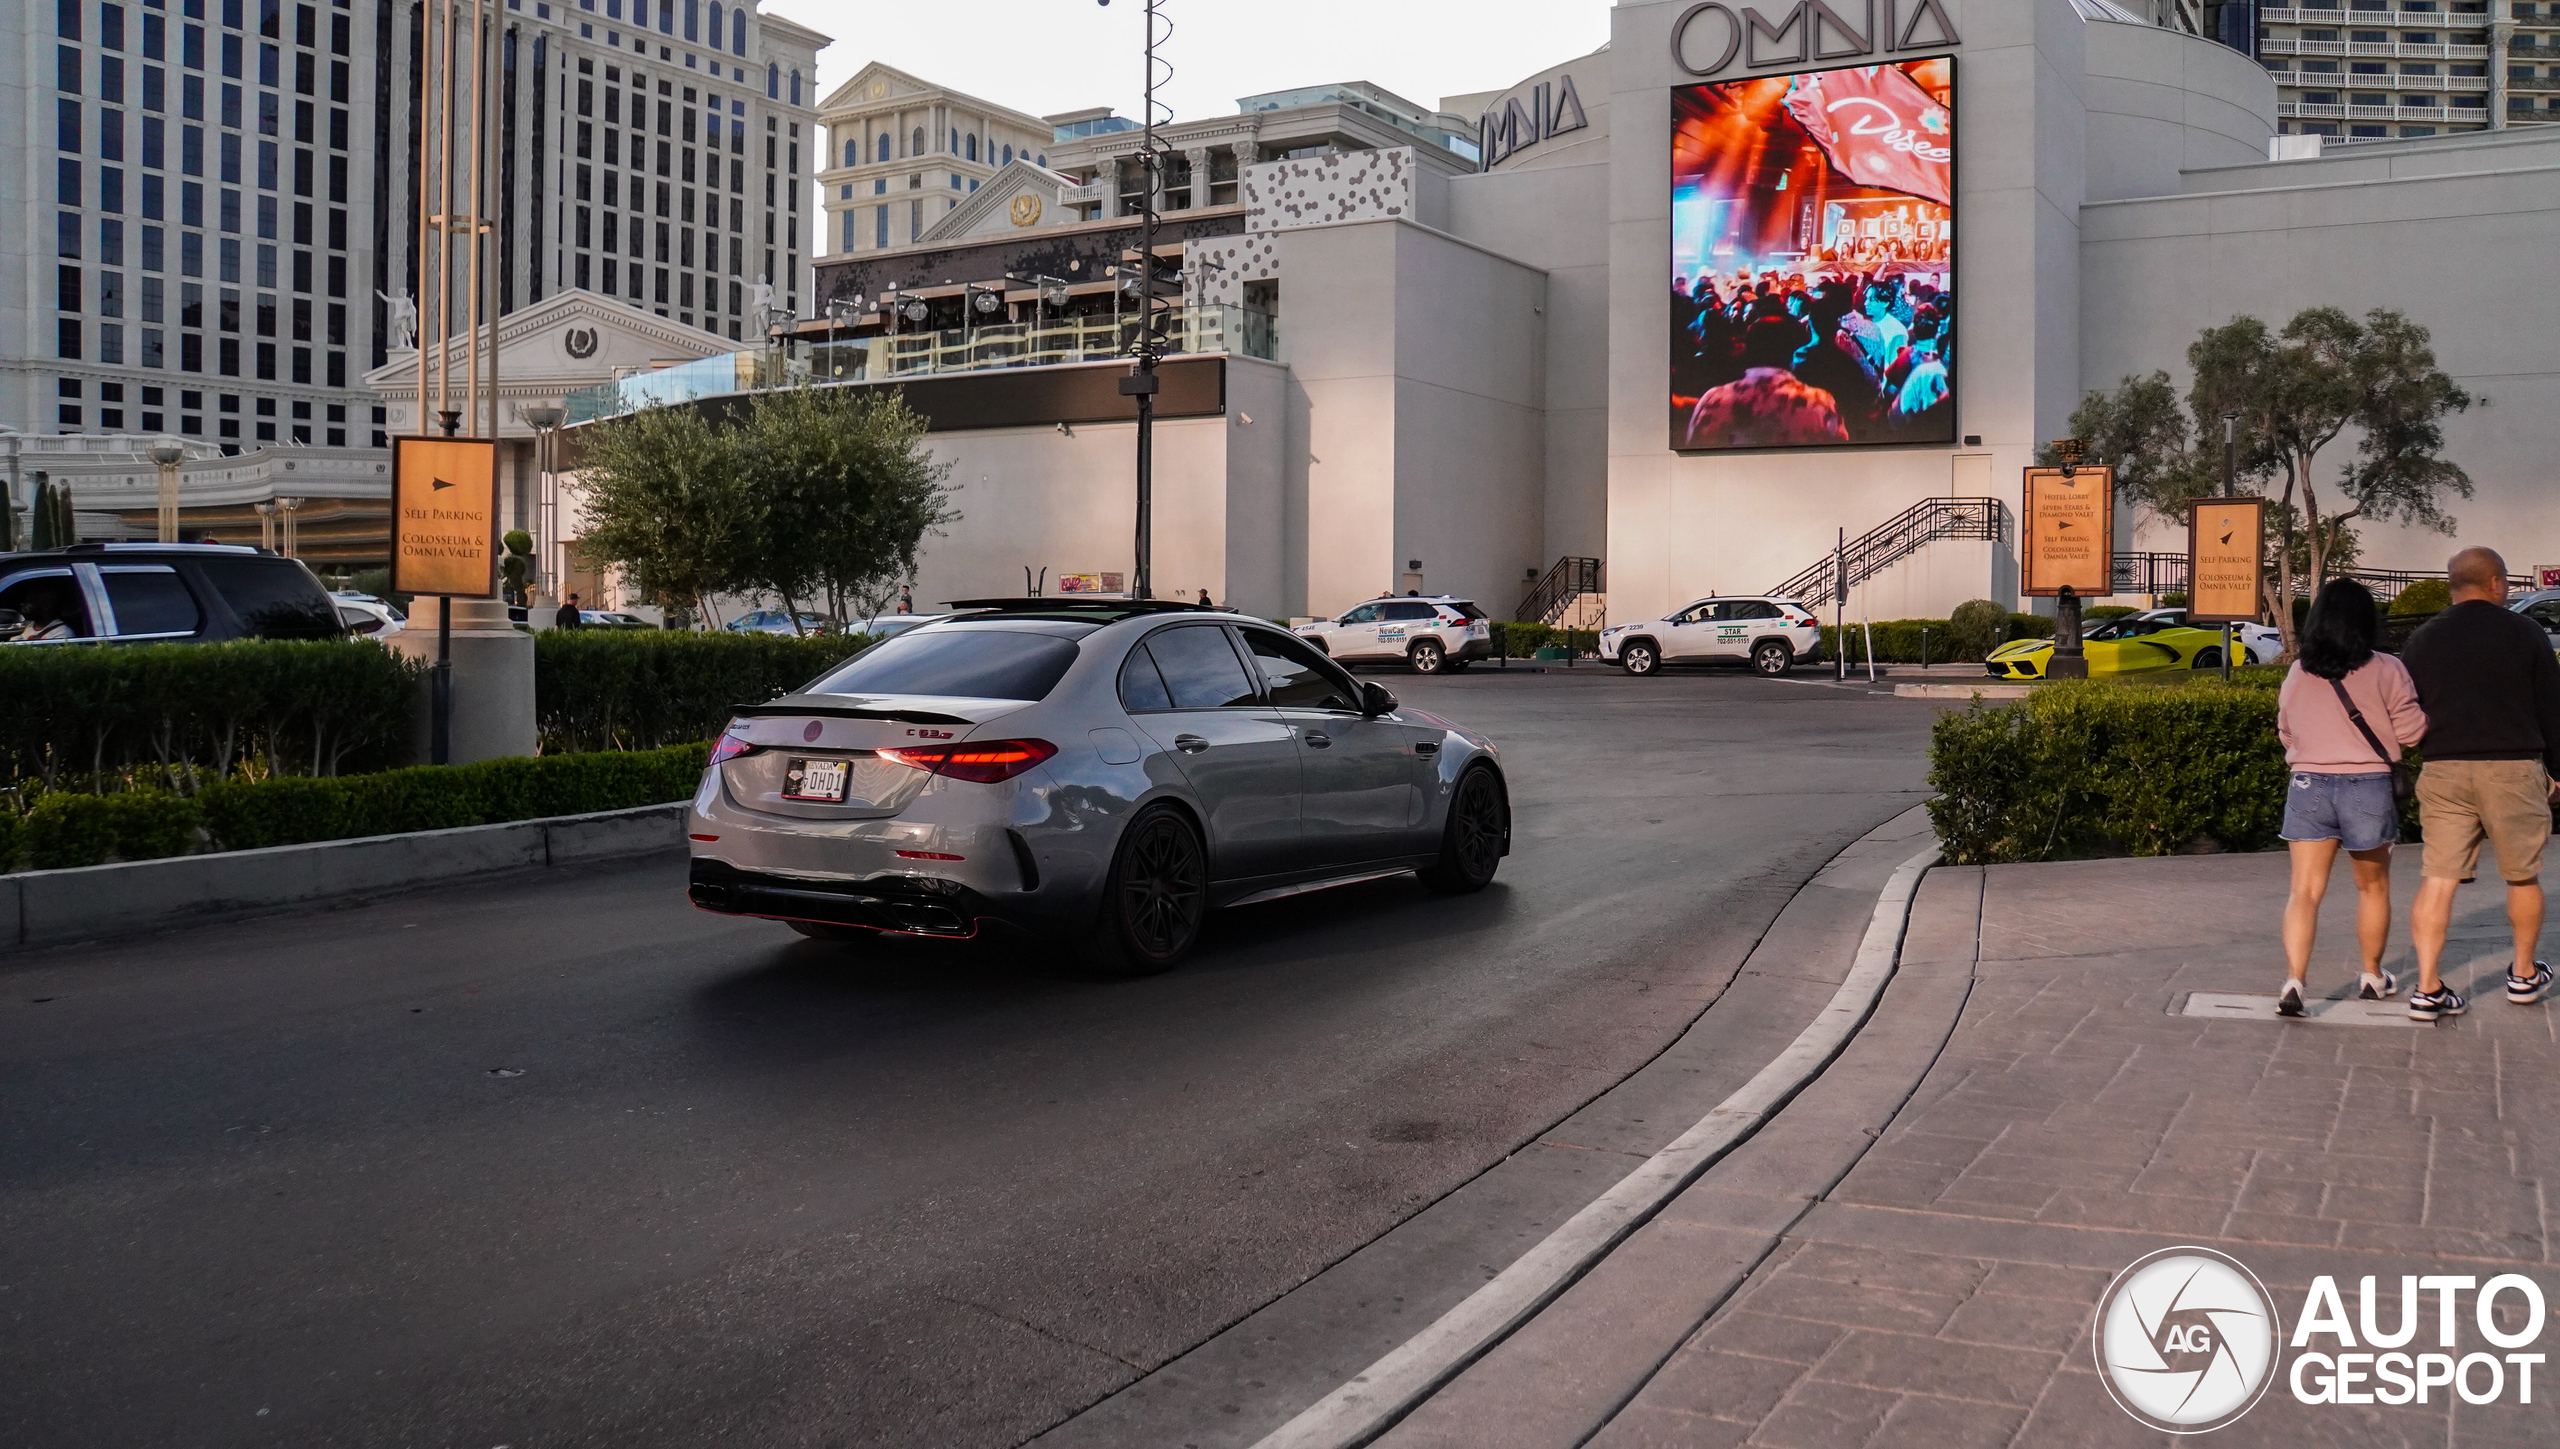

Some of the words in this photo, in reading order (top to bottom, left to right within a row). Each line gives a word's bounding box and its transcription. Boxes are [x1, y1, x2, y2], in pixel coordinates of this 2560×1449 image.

[1671, 0, 1961, 76] OMNIA
[1478, 74, 1588, 173] OMNIA
[404, 508, 429, 520] SELF
[433, 508, 483, 521] PARKING
[402, 532, 471, 546] COLOSSEUM
[474, 534, 484, 546] &
[403, 546, 445, 557] OMNIA
[448, 547, 482, 559] VALET
[2200, 556, 2216, 564] SELF
[2218, 555, 2252, 564] PARKING
[2198, 573, 2244, 582] COLOSSEUM
[2245, 573, 2252, 581] &
[2199, 582, 2227, 590] OMNIA
[2228, 582, 2252, 591] VALET
[906, 728, 916, 736] C
